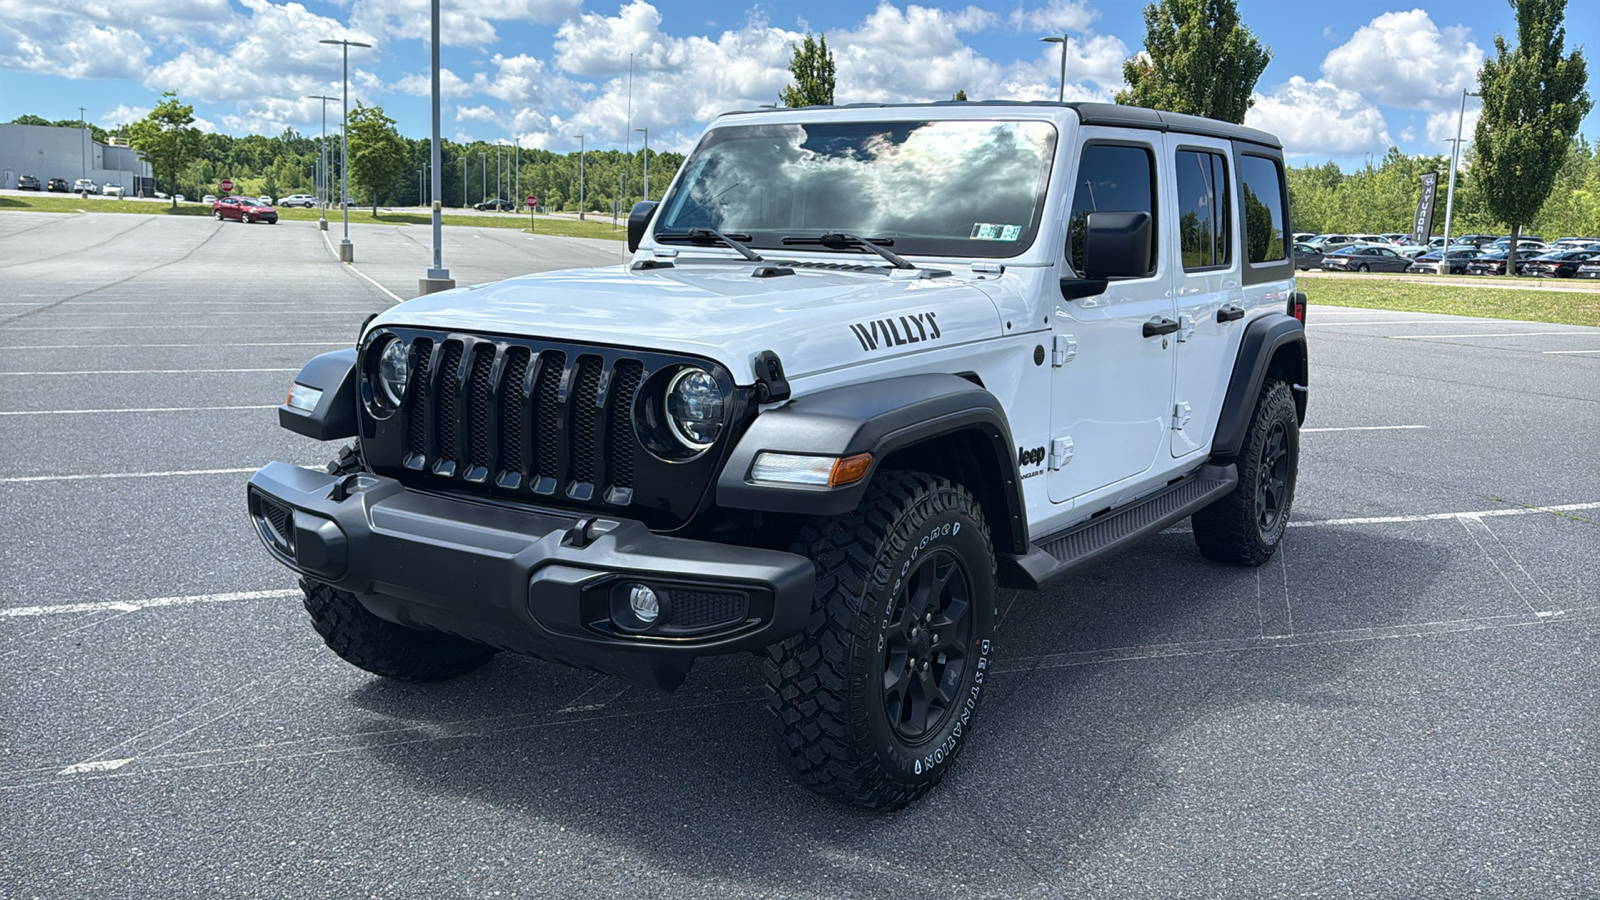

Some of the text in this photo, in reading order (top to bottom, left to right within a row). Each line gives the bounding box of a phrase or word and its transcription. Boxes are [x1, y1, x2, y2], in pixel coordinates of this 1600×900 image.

[1416, 187, 1432, 241] HYUNDAI
[849, 312, 941, 352] WILLYS
[1018, 446, 1045, 467] Jeep
[923, 639, 990, 772] DESTINATION
